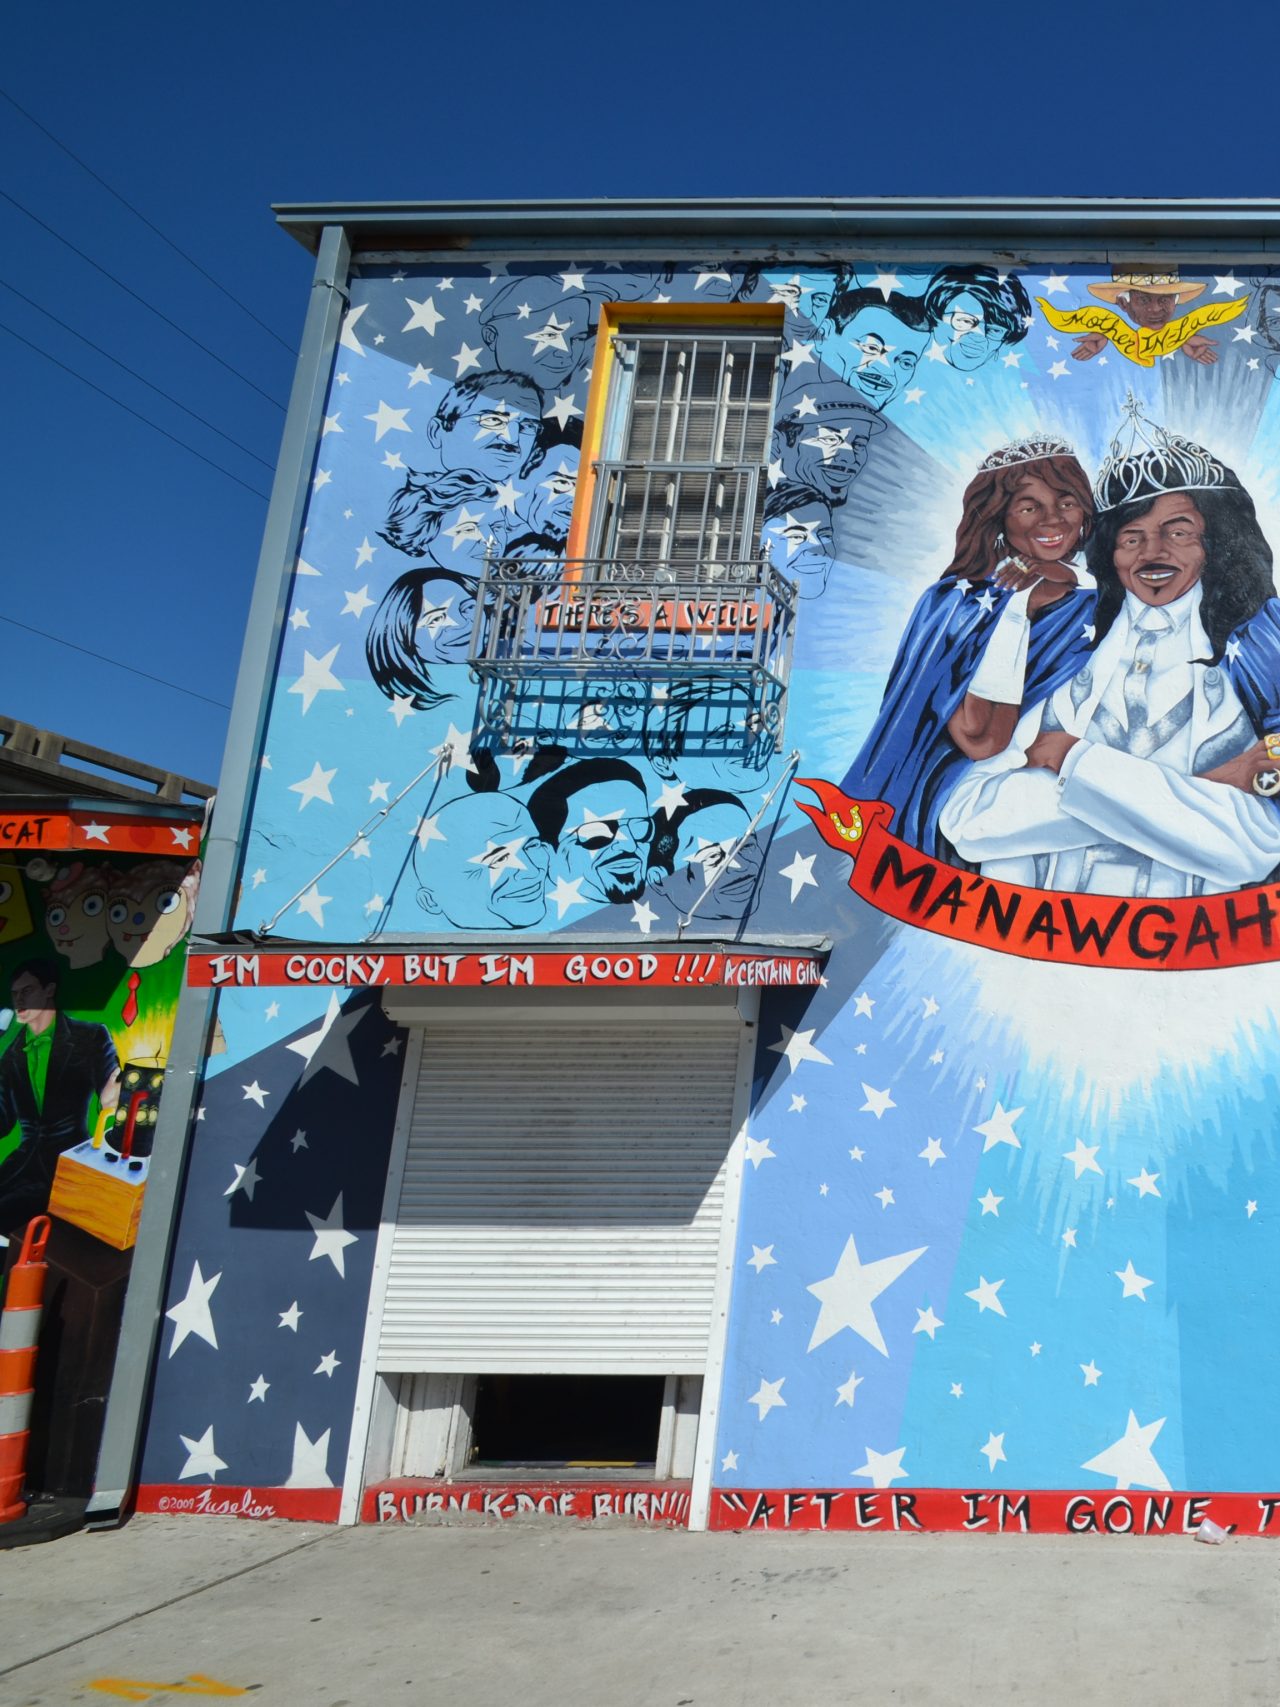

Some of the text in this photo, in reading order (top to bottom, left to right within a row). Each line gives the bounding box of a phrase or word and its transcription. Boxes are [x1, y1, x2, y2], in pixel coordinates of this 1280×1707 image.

[684, 601, 761, 627] WILL
[209, 954, 259, 985] I'M
[402, 954, 467, 983] BUT
[479, 954, 535, 985] I'M
[565, 954, 659, 982] GOOD
[737, 958, 792, 986] CERTAIN
[961, 1493, 1030, 1532] I'M
